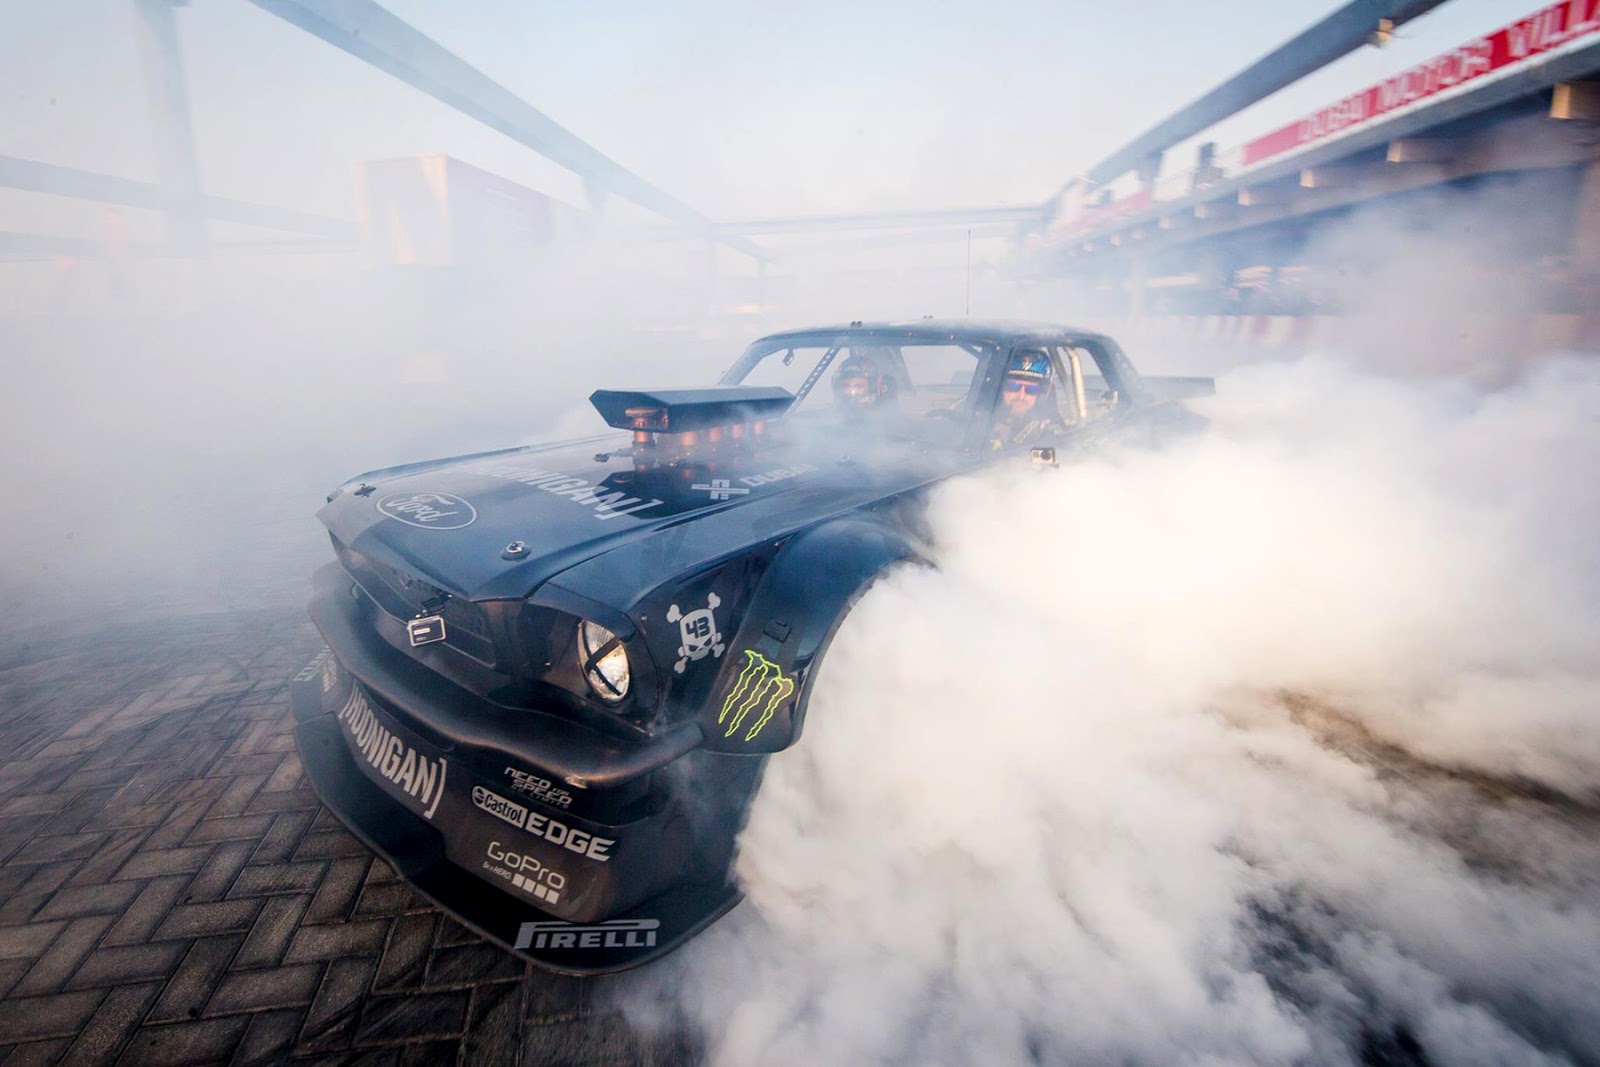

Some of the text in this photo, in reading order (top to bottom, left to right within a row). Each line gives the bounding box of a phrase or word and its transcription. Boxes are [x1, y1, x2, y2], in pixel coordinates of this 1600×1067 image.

[386, 494, 459, 522] Ford
[685, 616, 711, 639] 43
[504, 766, 551, 790] NEED
[512, 778, 573, 805] SPEED
[484, 793, 616, 862] Castrol EDGE
[486, 841, 566, 890] GoPro
[514, 918, 660, 949] PIRELLI
